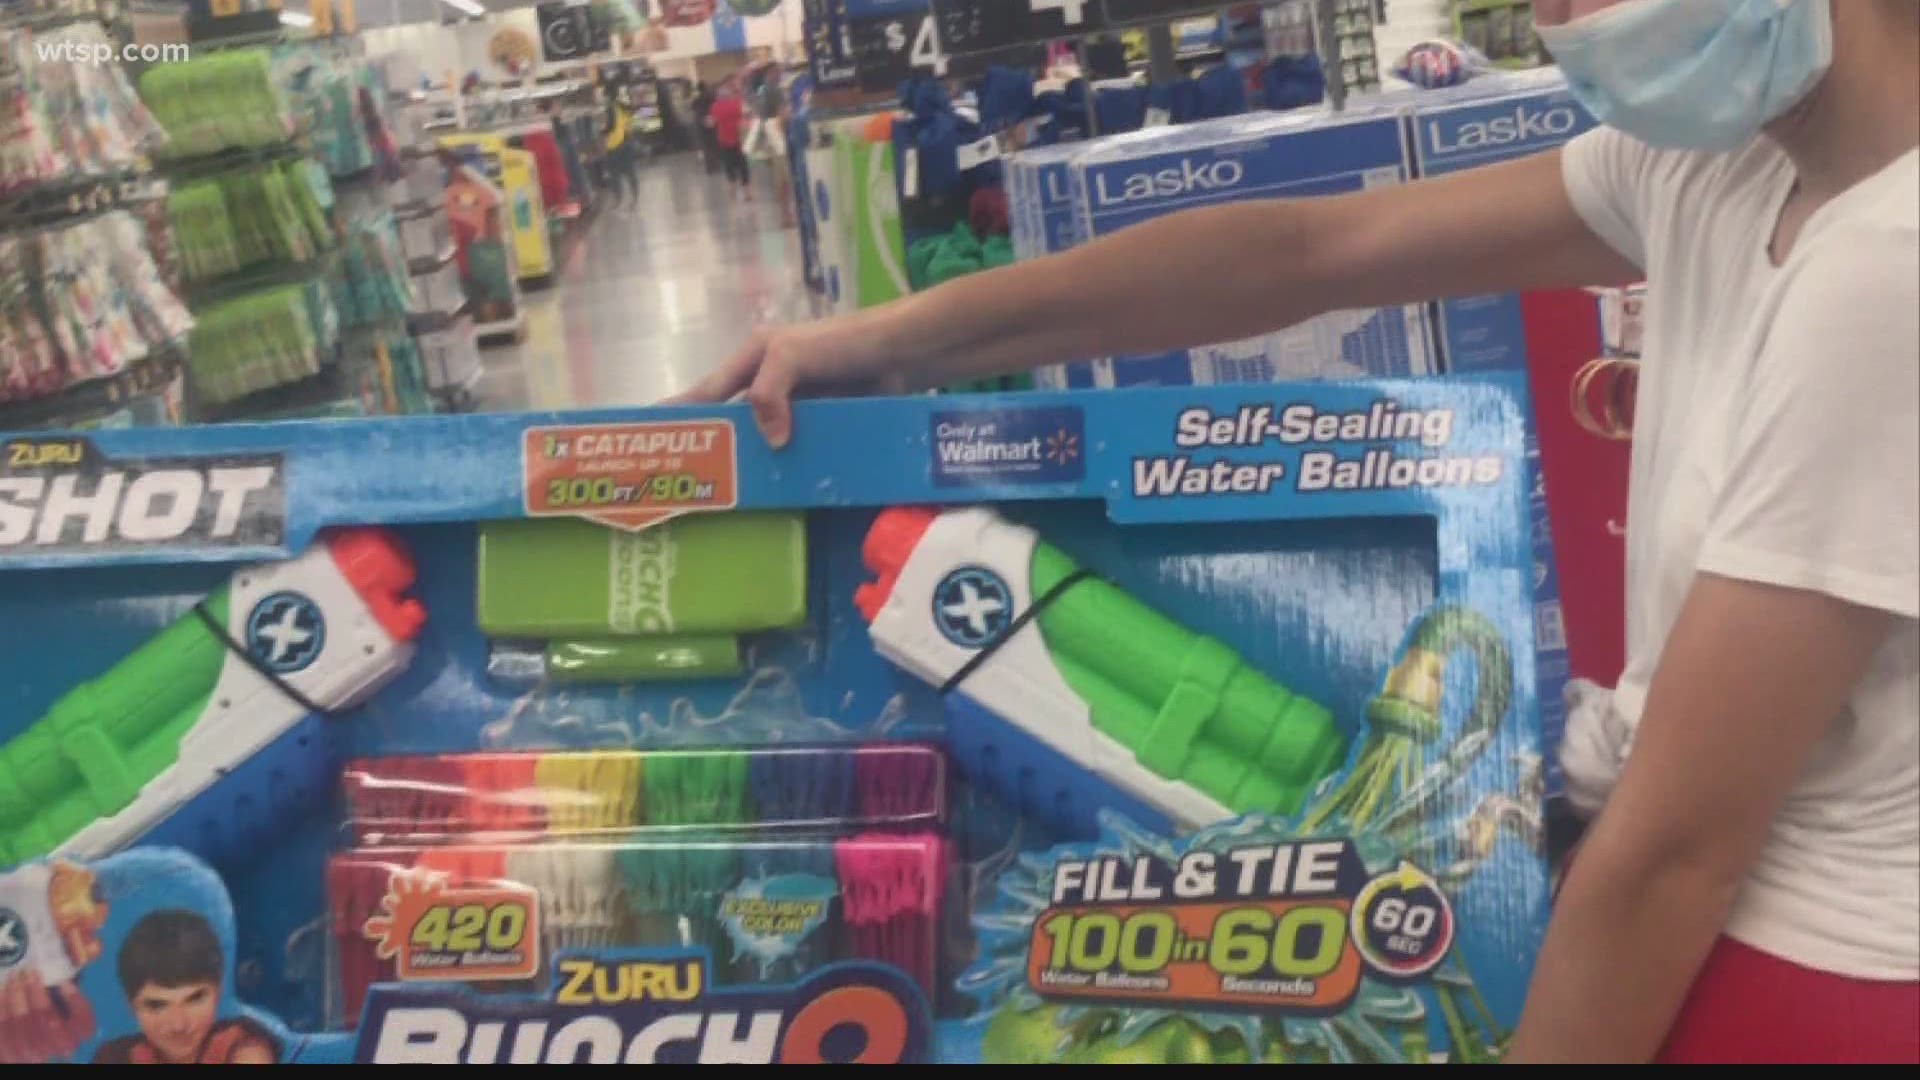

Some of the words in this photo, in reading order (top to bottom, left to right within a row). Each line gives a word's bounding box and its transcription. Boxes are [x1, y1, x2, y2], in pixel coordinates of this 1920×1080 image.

[1429, 106, 1576, 155] Lasko
[1096, 158, 1244, 205] Lasko
[575, 430, 719, 456] CATAPULT
[936, 422, 977, 442] Only
[1175, 402, 1454, 447] Self-Sealing
[938, 437, 1042, 463] Walmart
[1131, 456, 1283, 497] Water
[1298, 450, 1503, 492] Balloons
[0, 466, 274, 545] SHOT
[1052, 857, 1162, 904] FILL
[1173, 852, 1217, 898] &
[1229, 841, 1346, 897] TIE
[411, 903, 526, 952] 420
[1372, 898, 1437, 936] 60
[1044, 911, 1175, 973] 100
[1209, 905, 1347, 977] 60
[1386, 936, 1423, 955] SEC
[557, 960, 702, 1004] ZURU
[1041, 970, 1092, 985] Water
[1095, 972, 1170, 990] Balloons
[1222, 976, 1316, 996] Seconds
